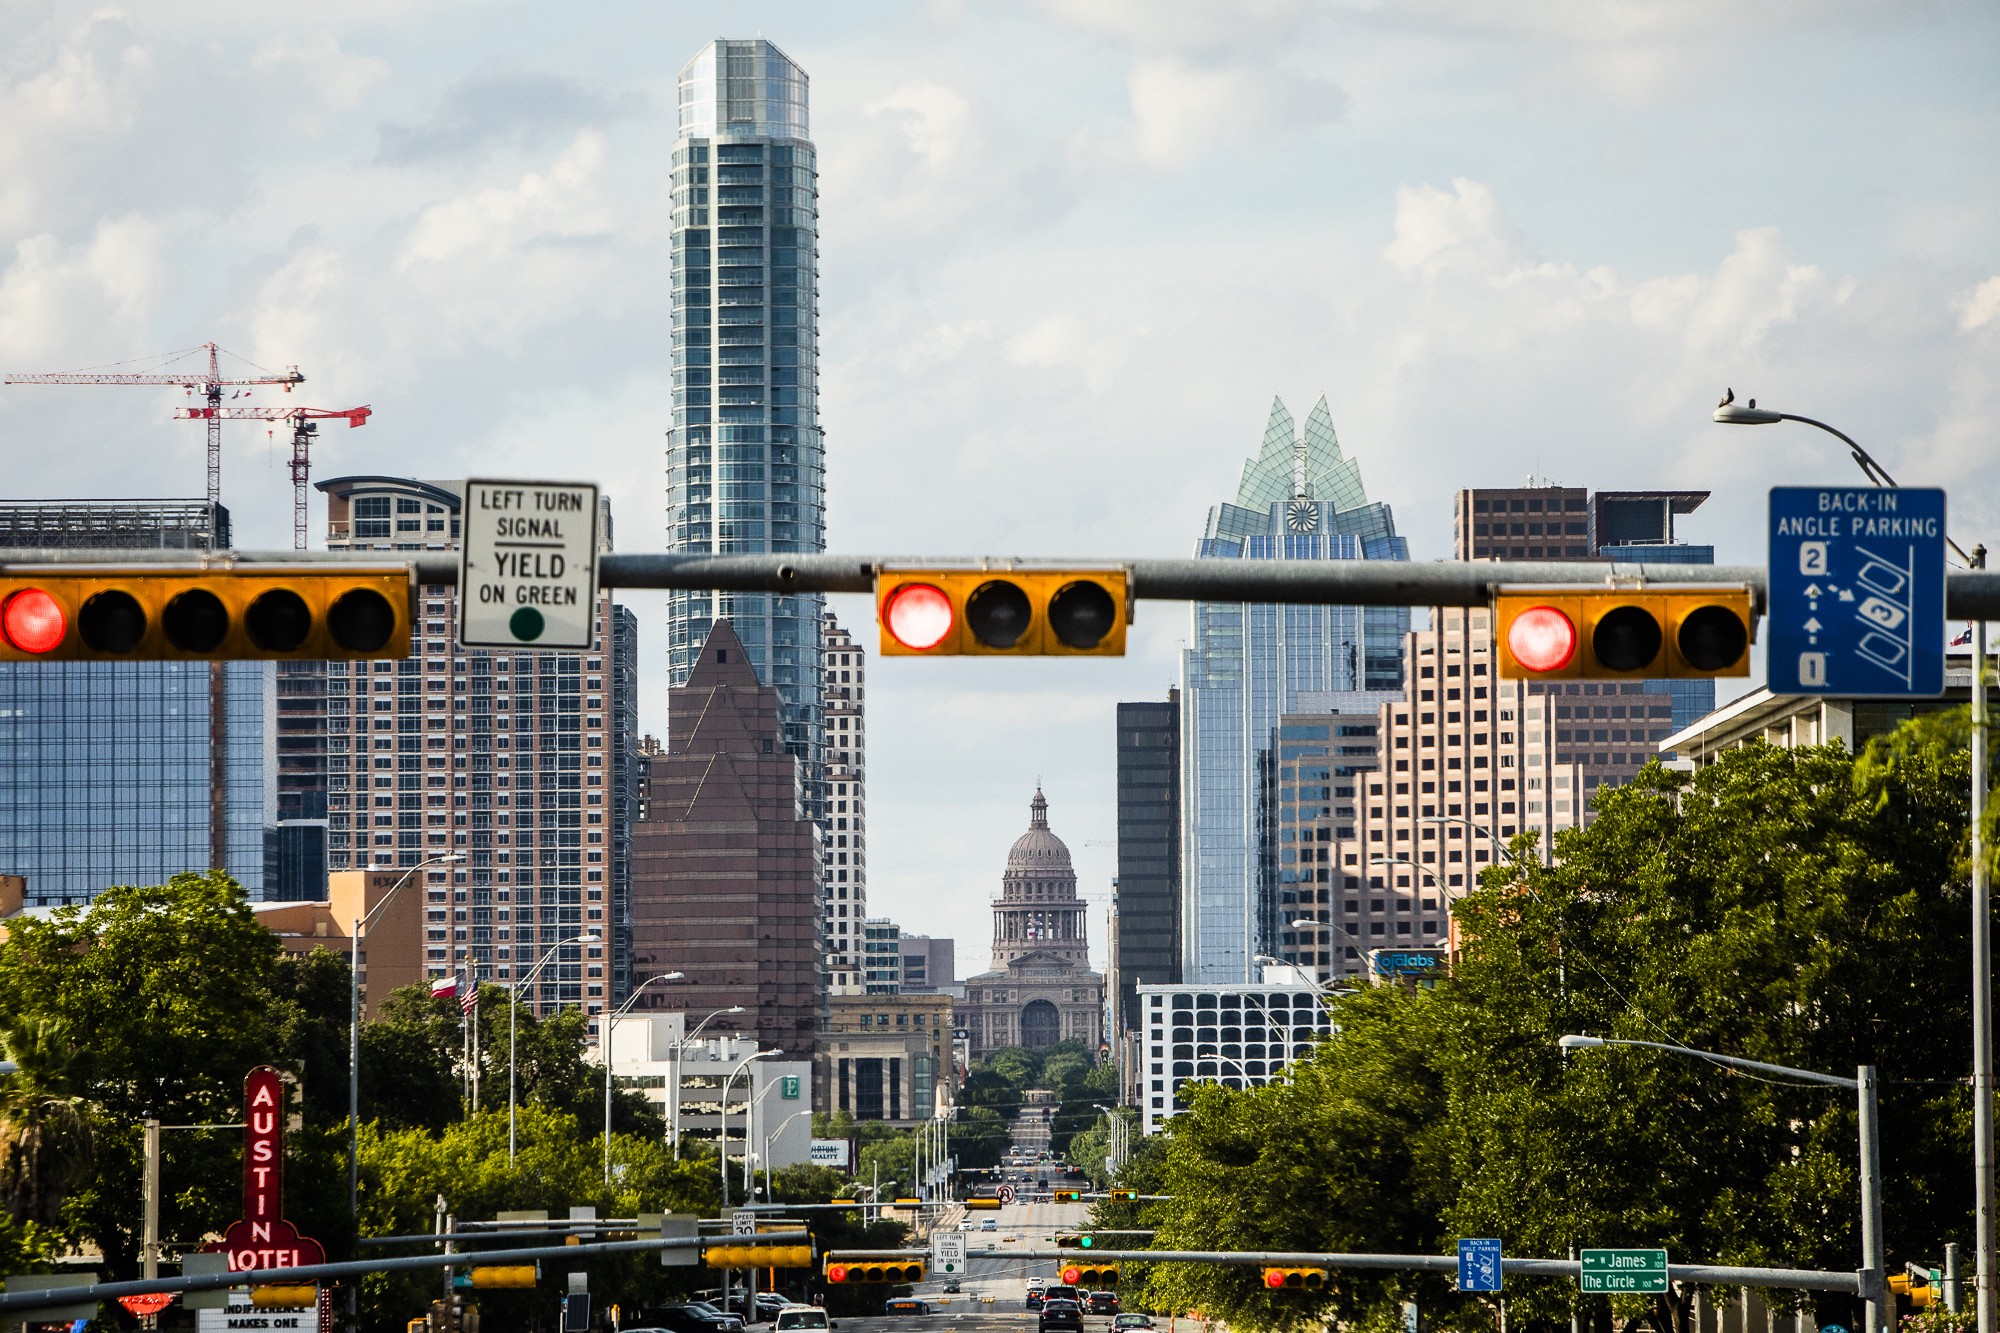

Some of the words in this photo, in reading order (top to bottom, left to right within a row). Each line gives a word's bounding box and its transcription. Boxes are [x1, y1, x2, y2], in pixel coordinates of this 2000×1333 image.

[481, 490, 523, 509] LEFT
[534, 492, 583, 511] TURN
[1818, 492, 1897, 512] BACK-IN
[496, 517, 563, 538] SIGNAL
[1777, 517, 1841, 536] ANGLE
[1851, 517, 1937, 537] PARKING
[494, 552, 565, 578] YIELD
[1806, 548, 1821, 568] 2
[479, 584, 505, 603] ON
[516, 585, 577, 605] GREEN
[1870, 604, 1893, 621] 3
[373, 877, 415, 888] HYAT
[252, 1085, 274, 1243] AUSTIN
[1608, 1253, 1647, 1268] James
[1584, 1274, 1602, 1288] The
[1606, 1274, 1636, 1288] Circle
[228, 1319, 268, 1329] MAKES
[273, 1319, 298, 1328] ONE
